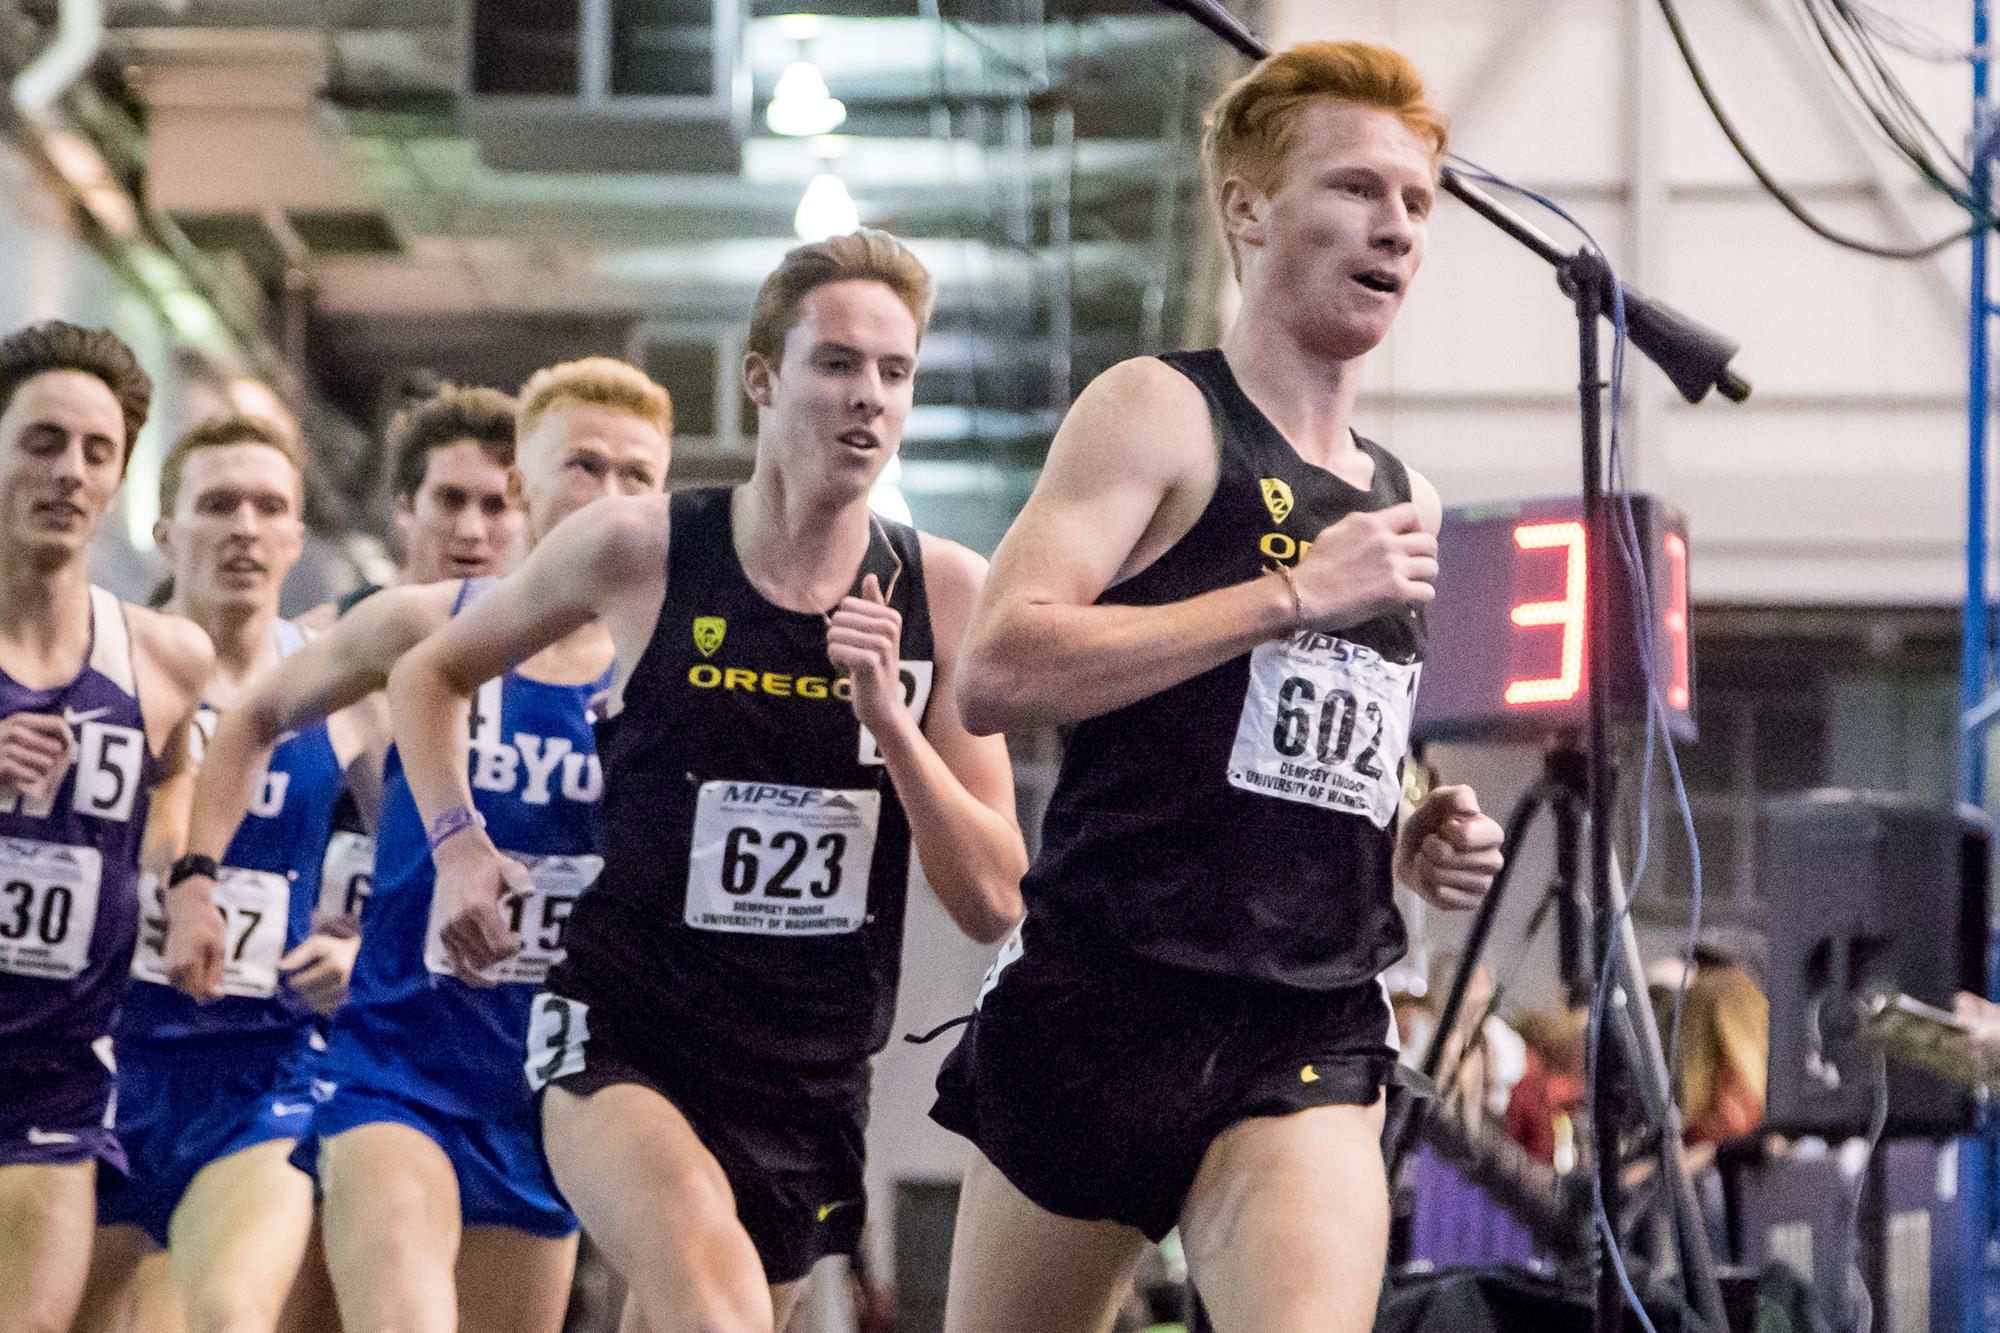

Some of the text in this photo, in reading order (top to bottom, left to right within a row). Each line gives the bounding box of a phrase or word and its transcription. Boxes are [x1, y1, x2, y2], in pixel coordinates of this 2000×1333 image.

[1504, 519, 1587, 706] 3
[688, 664, 851, 702] OREGO
[1273, 676, 1383, 781] 602
[92, 733, 128, 810] 5
[472, 732, 605, 805] BYU
[723, 783, 823, 808] MPSF
[1246, 770, 1307, 796] UNIVERSITY
[1308, 784, 1325, 799] OF
[1280, 761, 1330, 784] DEMPSEY
[721, 826, 848, 900] 623
[0, 881, 73, 945] 30
[505, 892, 575, 950] 15
[702, 912, 849, 930] UNIVERSITY OF WASHINGTON
[733, 901, 783, 915] DEMPSEY
